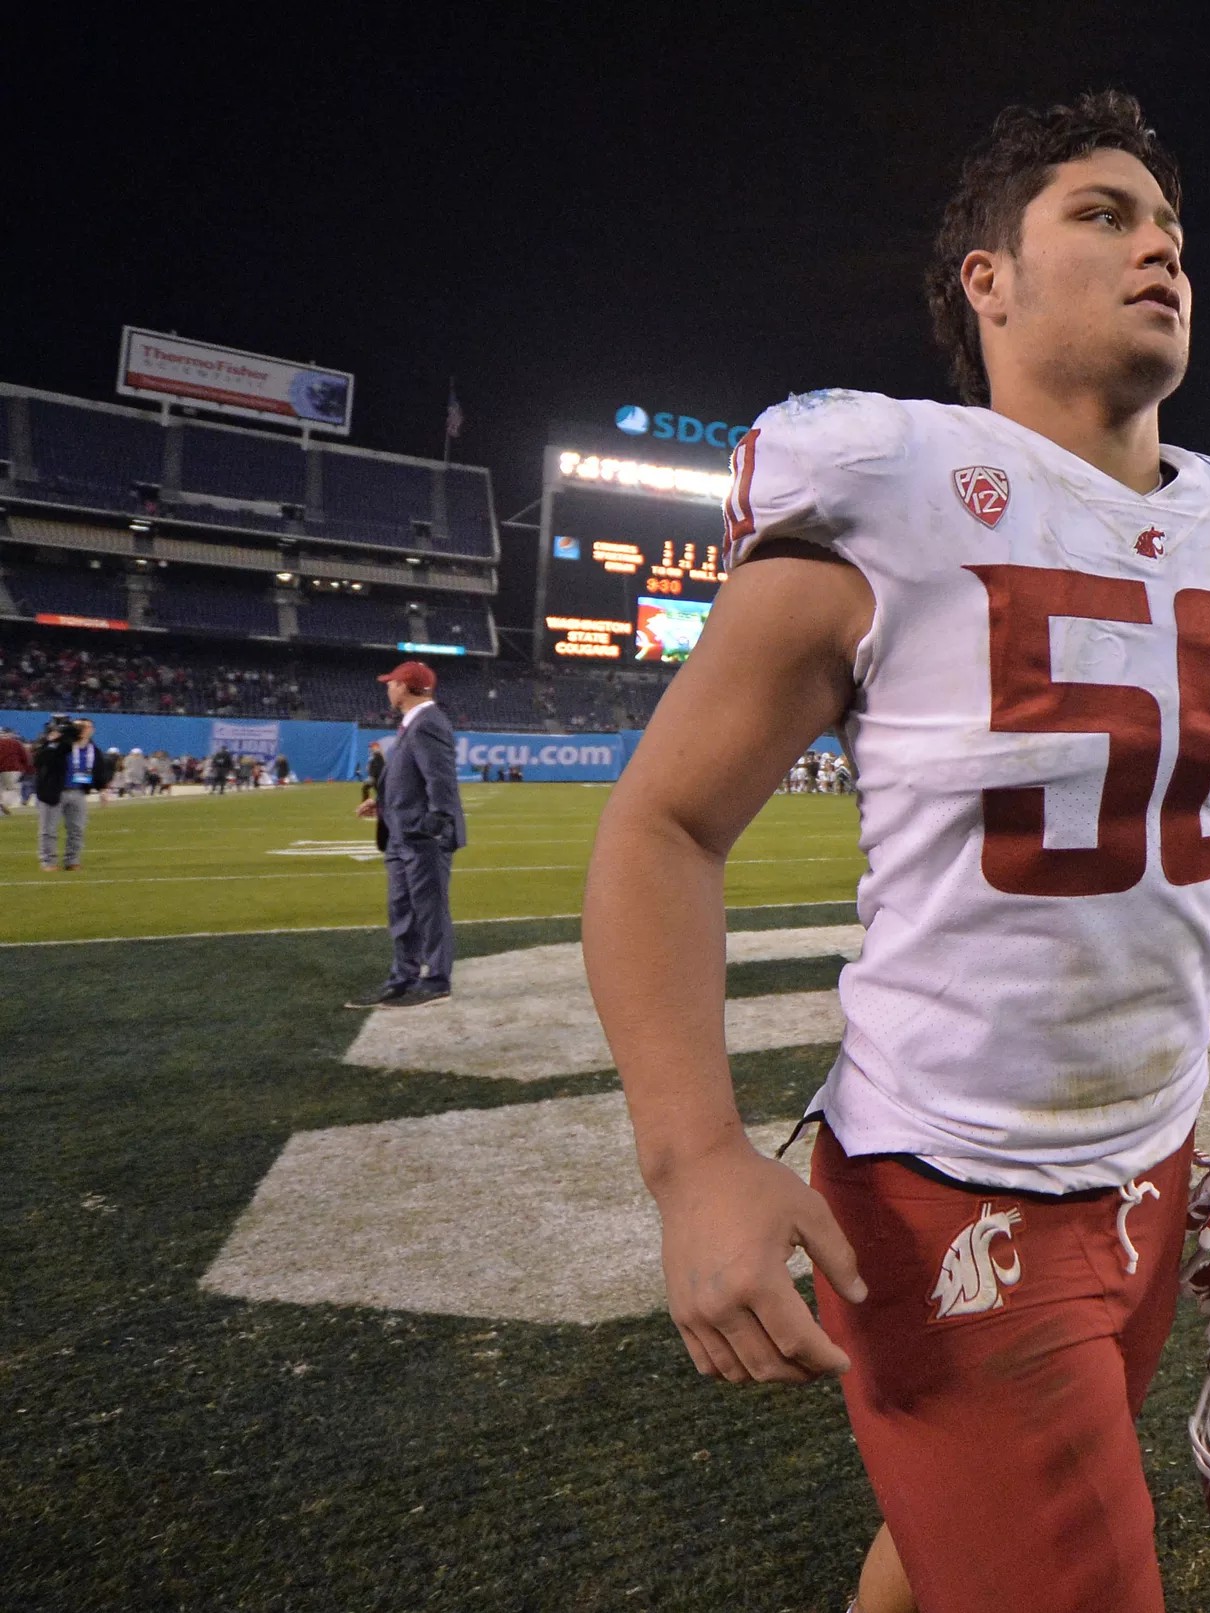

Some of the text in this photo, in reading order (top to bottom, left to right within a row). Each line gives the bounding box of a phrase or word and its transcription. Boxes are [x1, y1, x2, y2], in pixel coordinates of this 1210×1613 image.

[953, 467, 1008, 503] PAC
[972, 490, 1003, 514] 12
[567, 630, 610, 644] STATE
